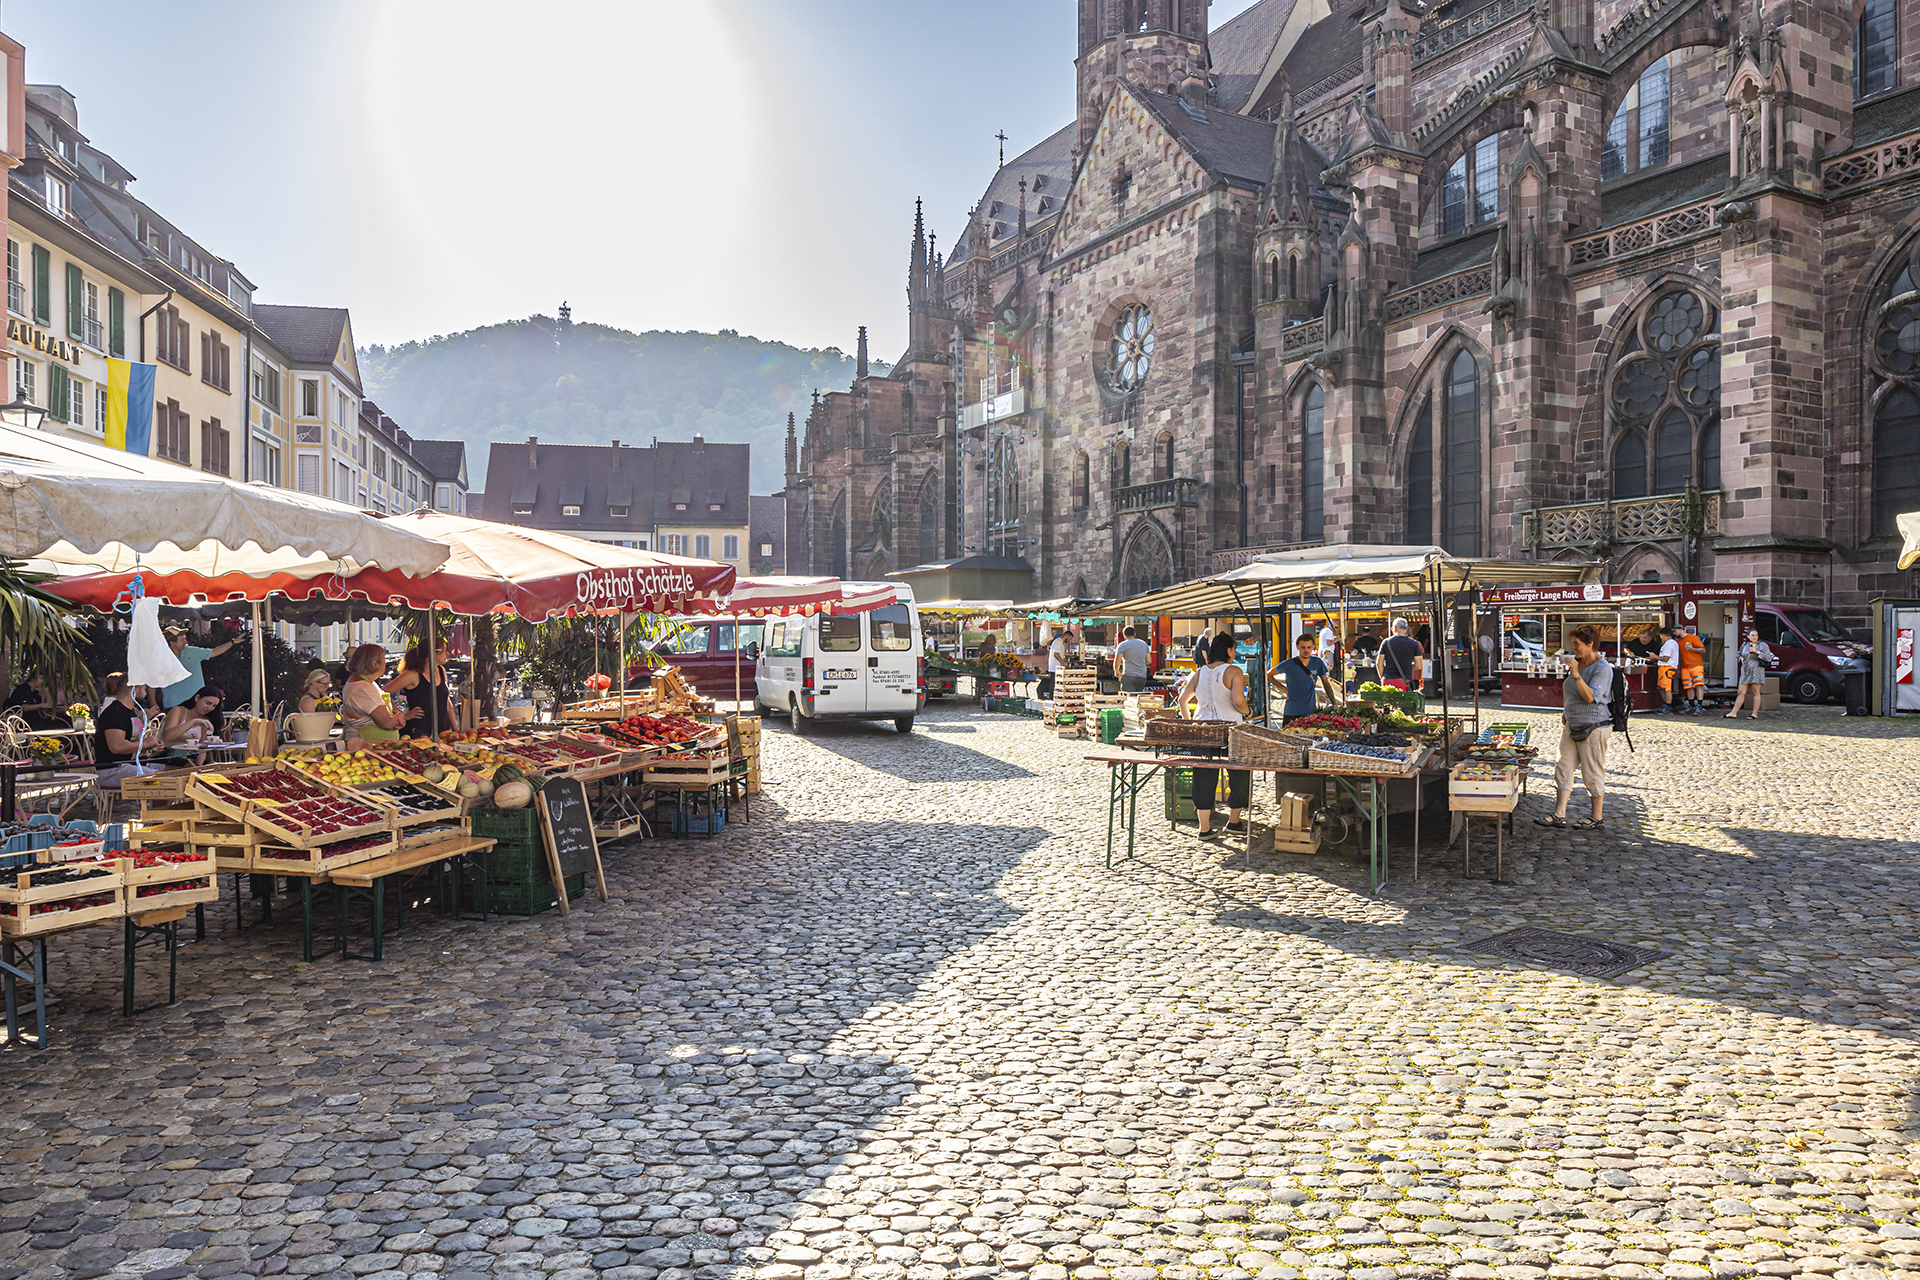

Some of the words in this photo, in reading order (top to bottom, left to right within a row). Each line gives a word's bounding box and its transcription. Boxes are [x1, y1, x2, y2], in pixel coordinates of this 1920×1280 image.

[8, 319, 84, 365] AURANT
[577, 568, 634, 602] Obsthof
[636, 567, 695, 595] Schätzle
[1504, 592, 1539, 601] Freiburger
[1540, 591, 1561, 601] Lange
[1562, 590, 1579, 599] Rote
